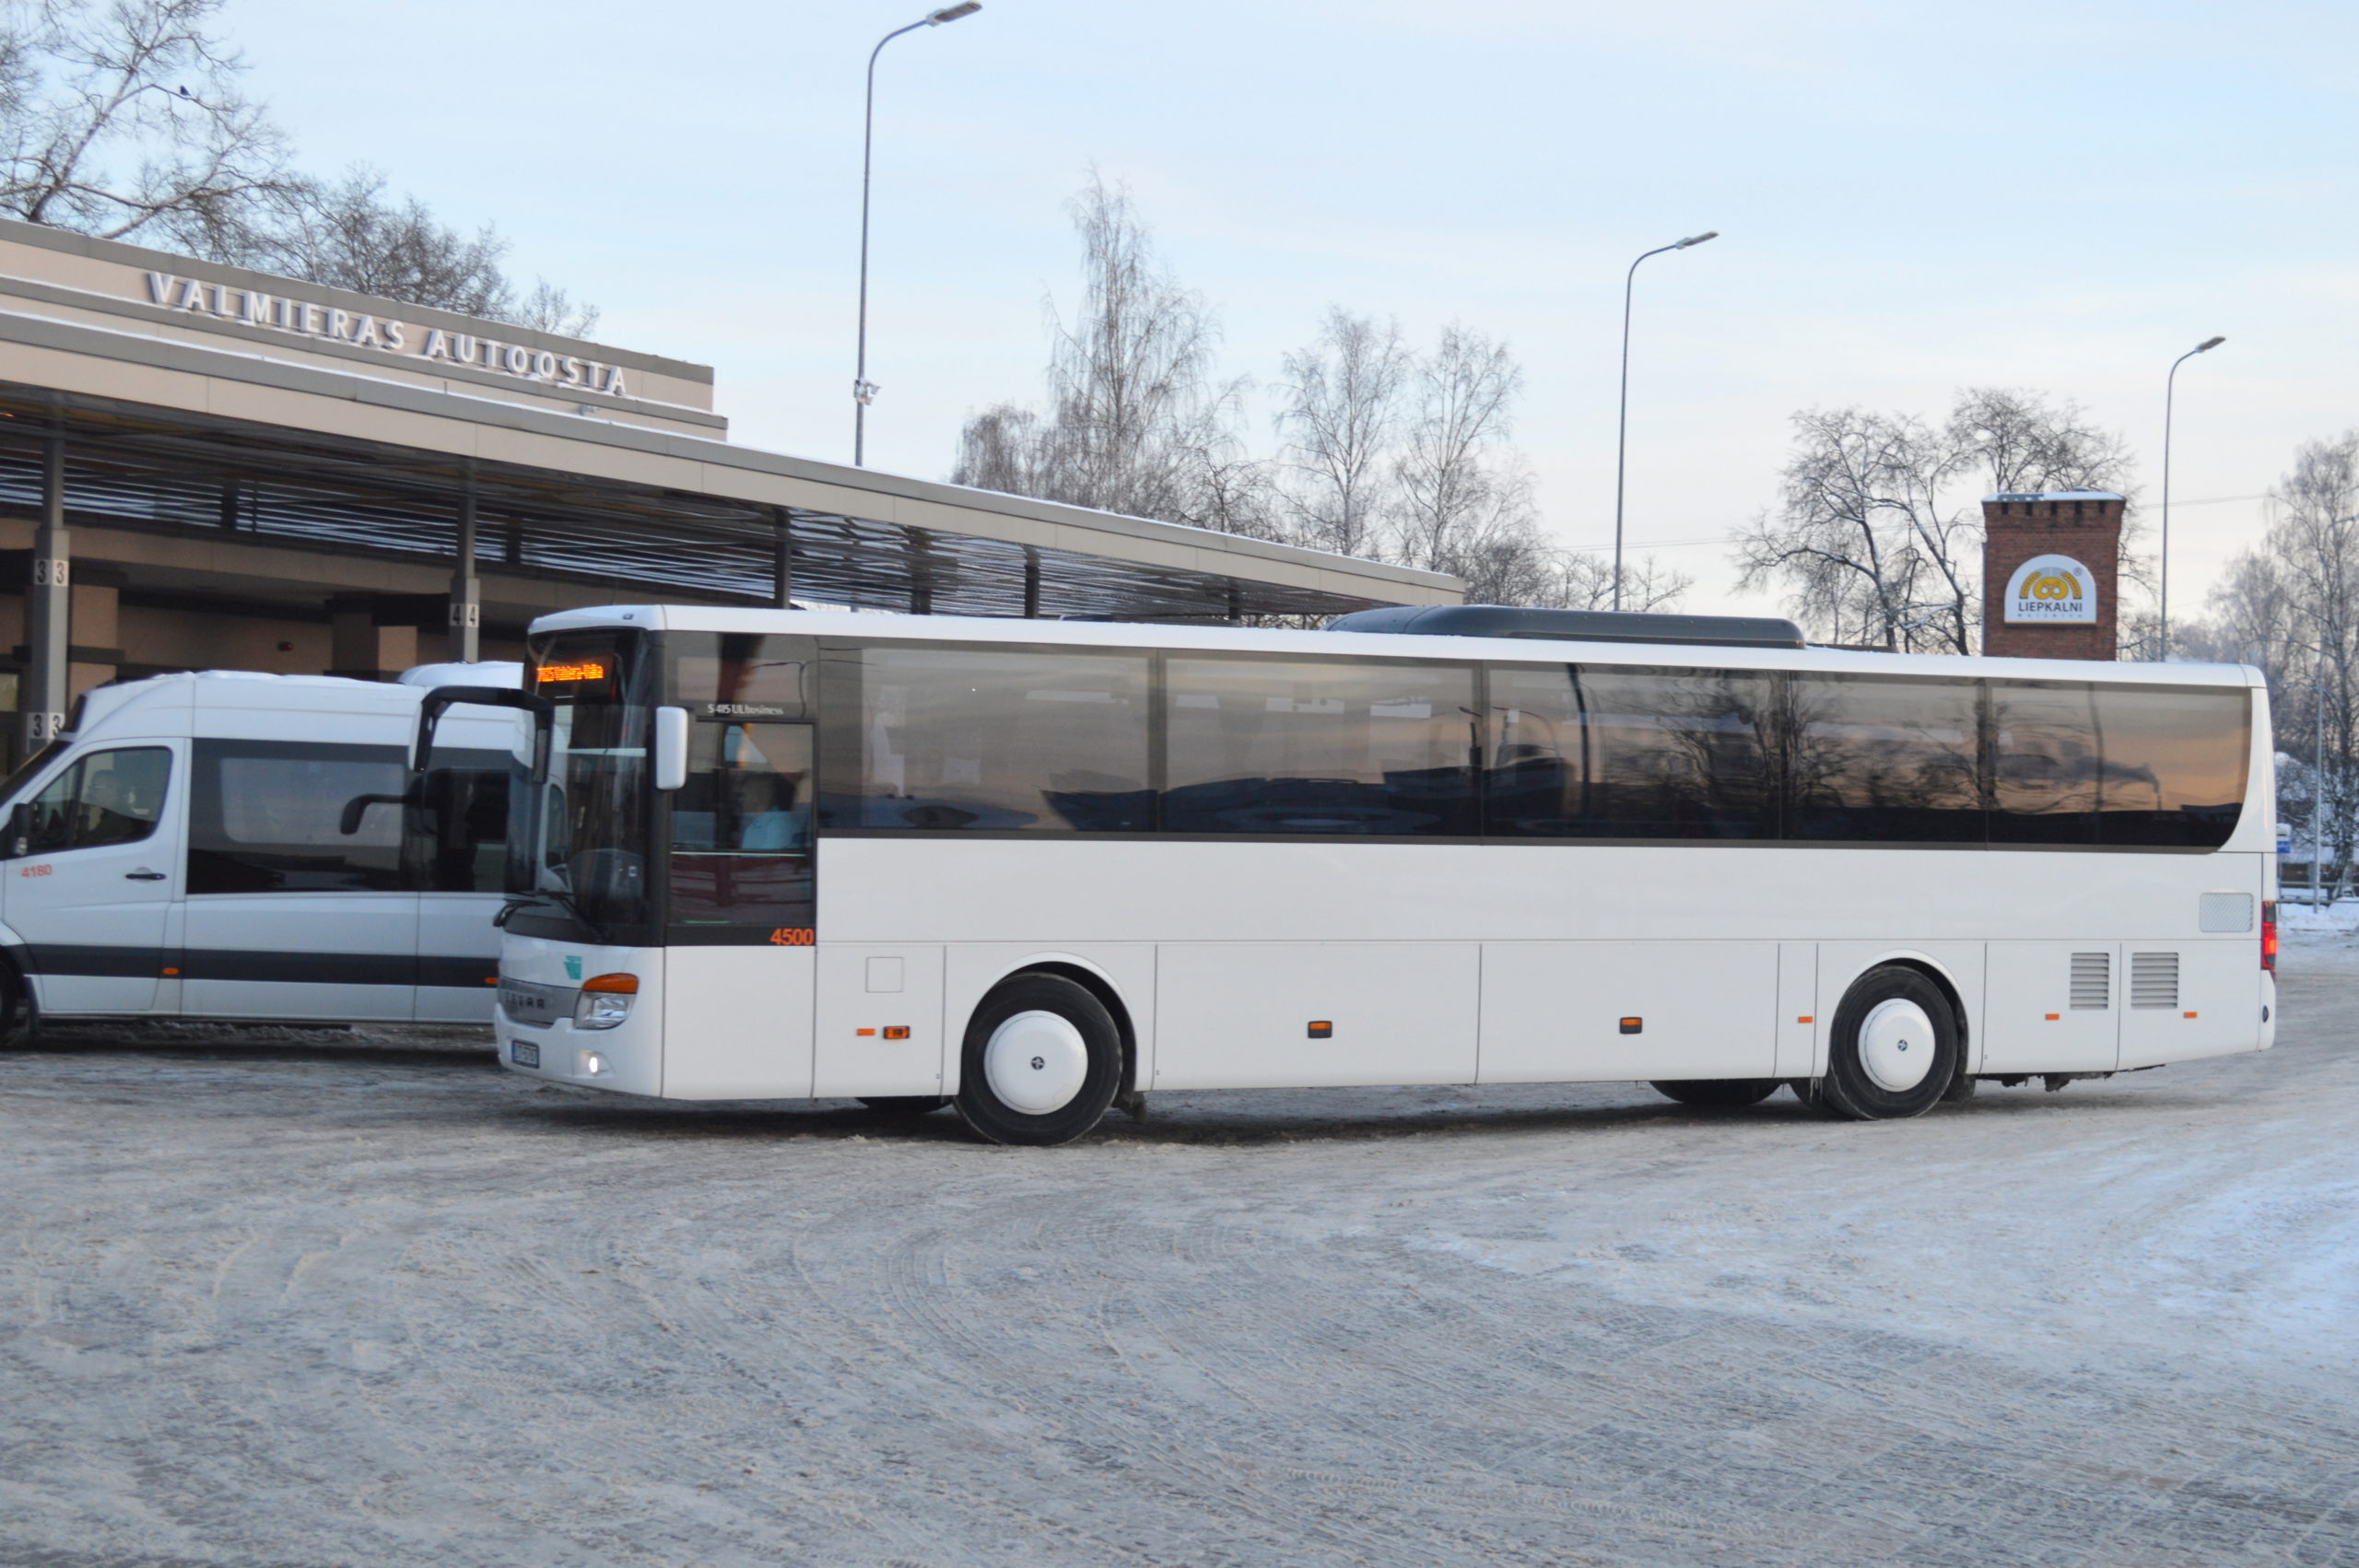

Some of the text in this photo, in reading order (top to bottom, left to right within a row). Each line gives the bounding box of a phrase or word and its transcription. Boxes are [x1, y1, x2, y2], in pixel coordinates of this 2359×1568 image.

[147, 271, 627, 394] VALMIERAS AUTOOSTA
[37, 560, 46, 583] 3
[56, 562, 65, 584] 3
[452, 604, 461, 626] 4
[469, 605, 475, 626] 4
[2018, 602, 2083, 612] LIEPKALNI
[33, 714, 42, 737] 3
[53, 715, 61, 736] 3
[21, 864, 53, 878] 4180
[770, 928, 815, 945] 4500
